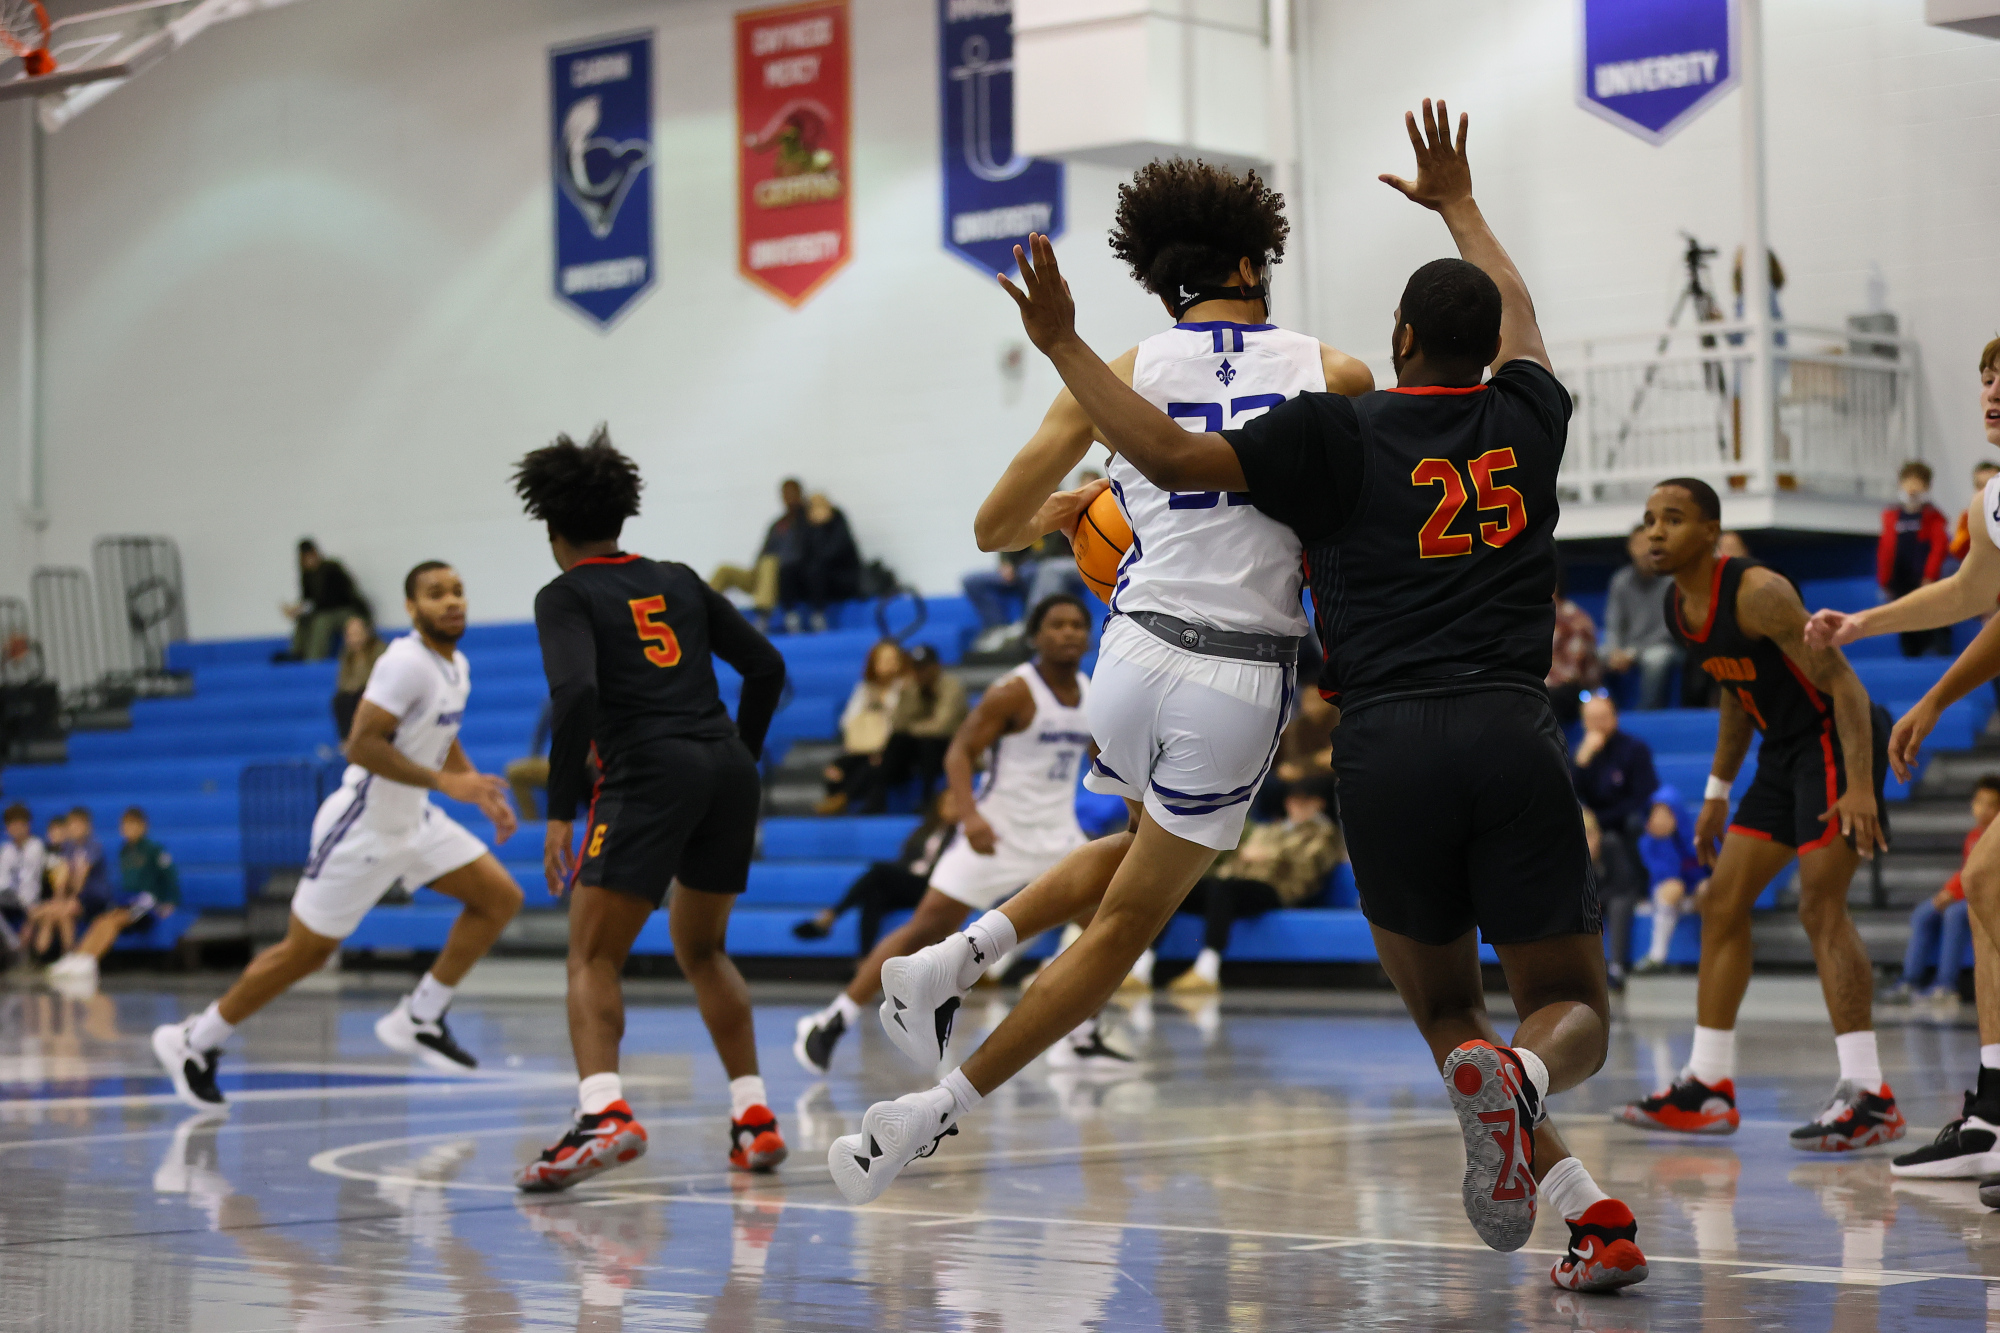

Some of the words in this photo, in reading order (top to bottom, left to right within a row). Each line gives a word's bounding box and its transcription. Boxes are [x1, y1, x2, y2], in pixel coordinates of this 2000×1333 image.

[1595, 51, 1718, 98] UNIVERSITY
[953, 204, 1051, 244] UNIVERSITY
[749, 231, 839, 269] UNIVERSITY
[563, 258, 646, 294] UNIVERSITY
[1411, 447, 1527, 559] 25
[629, 595, 682, 668] 5
